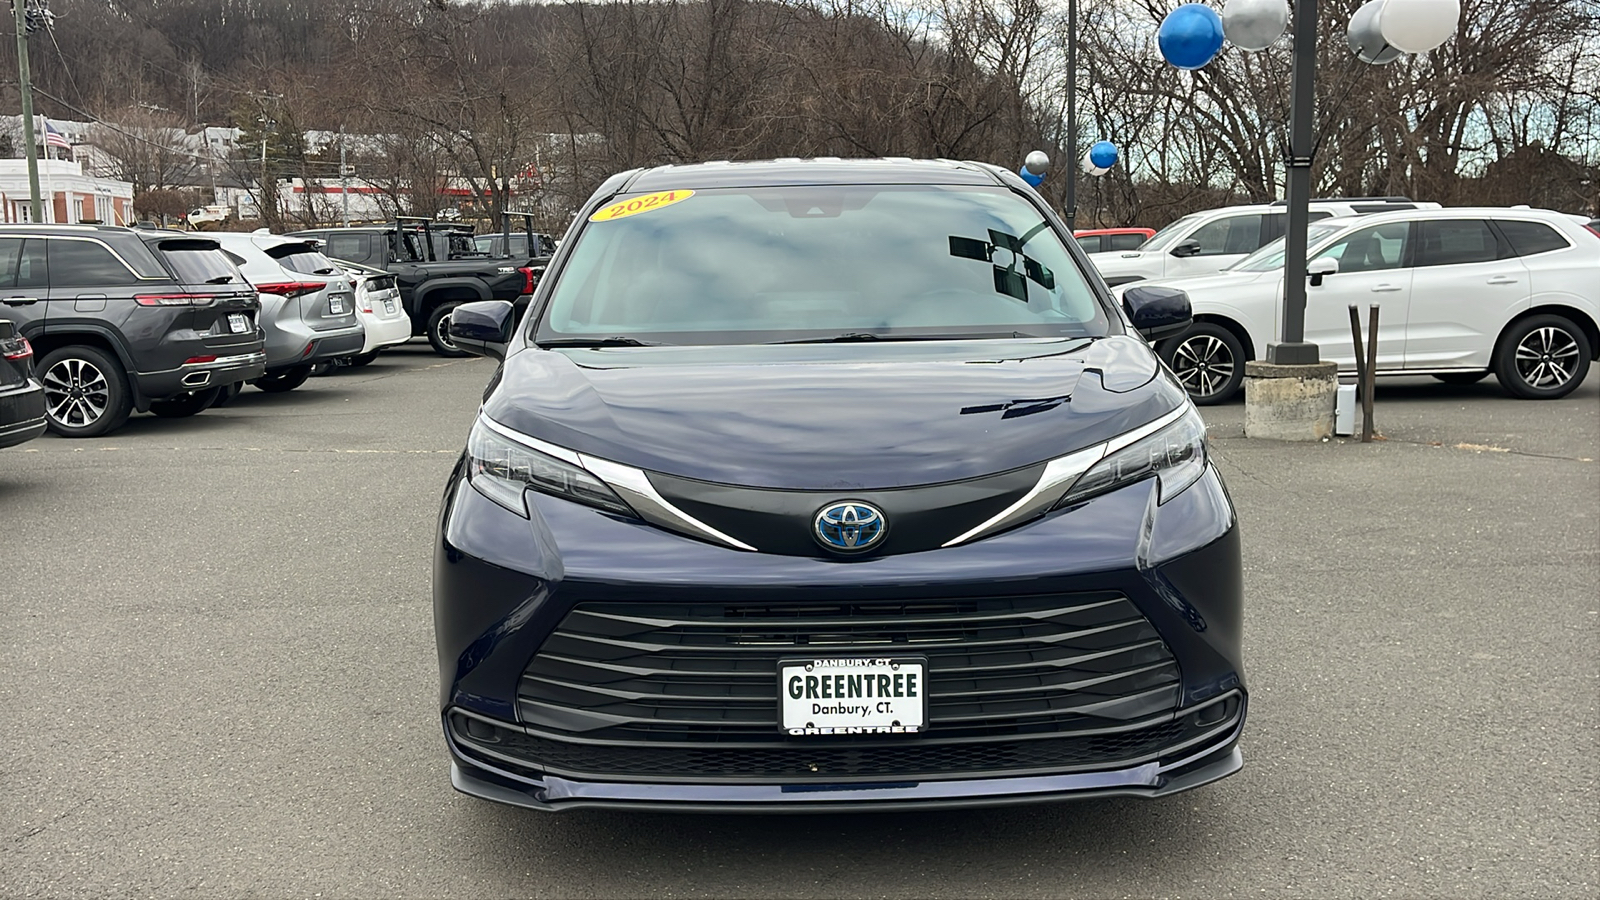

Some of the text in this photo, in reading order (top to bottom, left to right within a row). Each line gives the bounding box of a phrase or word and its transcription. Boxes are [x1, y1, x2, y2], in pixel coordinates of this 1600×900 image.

[610, 192, 678, 218] 2024
[814, 658, 892, 668] DANBURY, CT
[788, 673, 917, 700] GREENTREE
[812, 702, 894, 718] Danbury, CT.
[788, 726, 919, 736] GREENTREE
